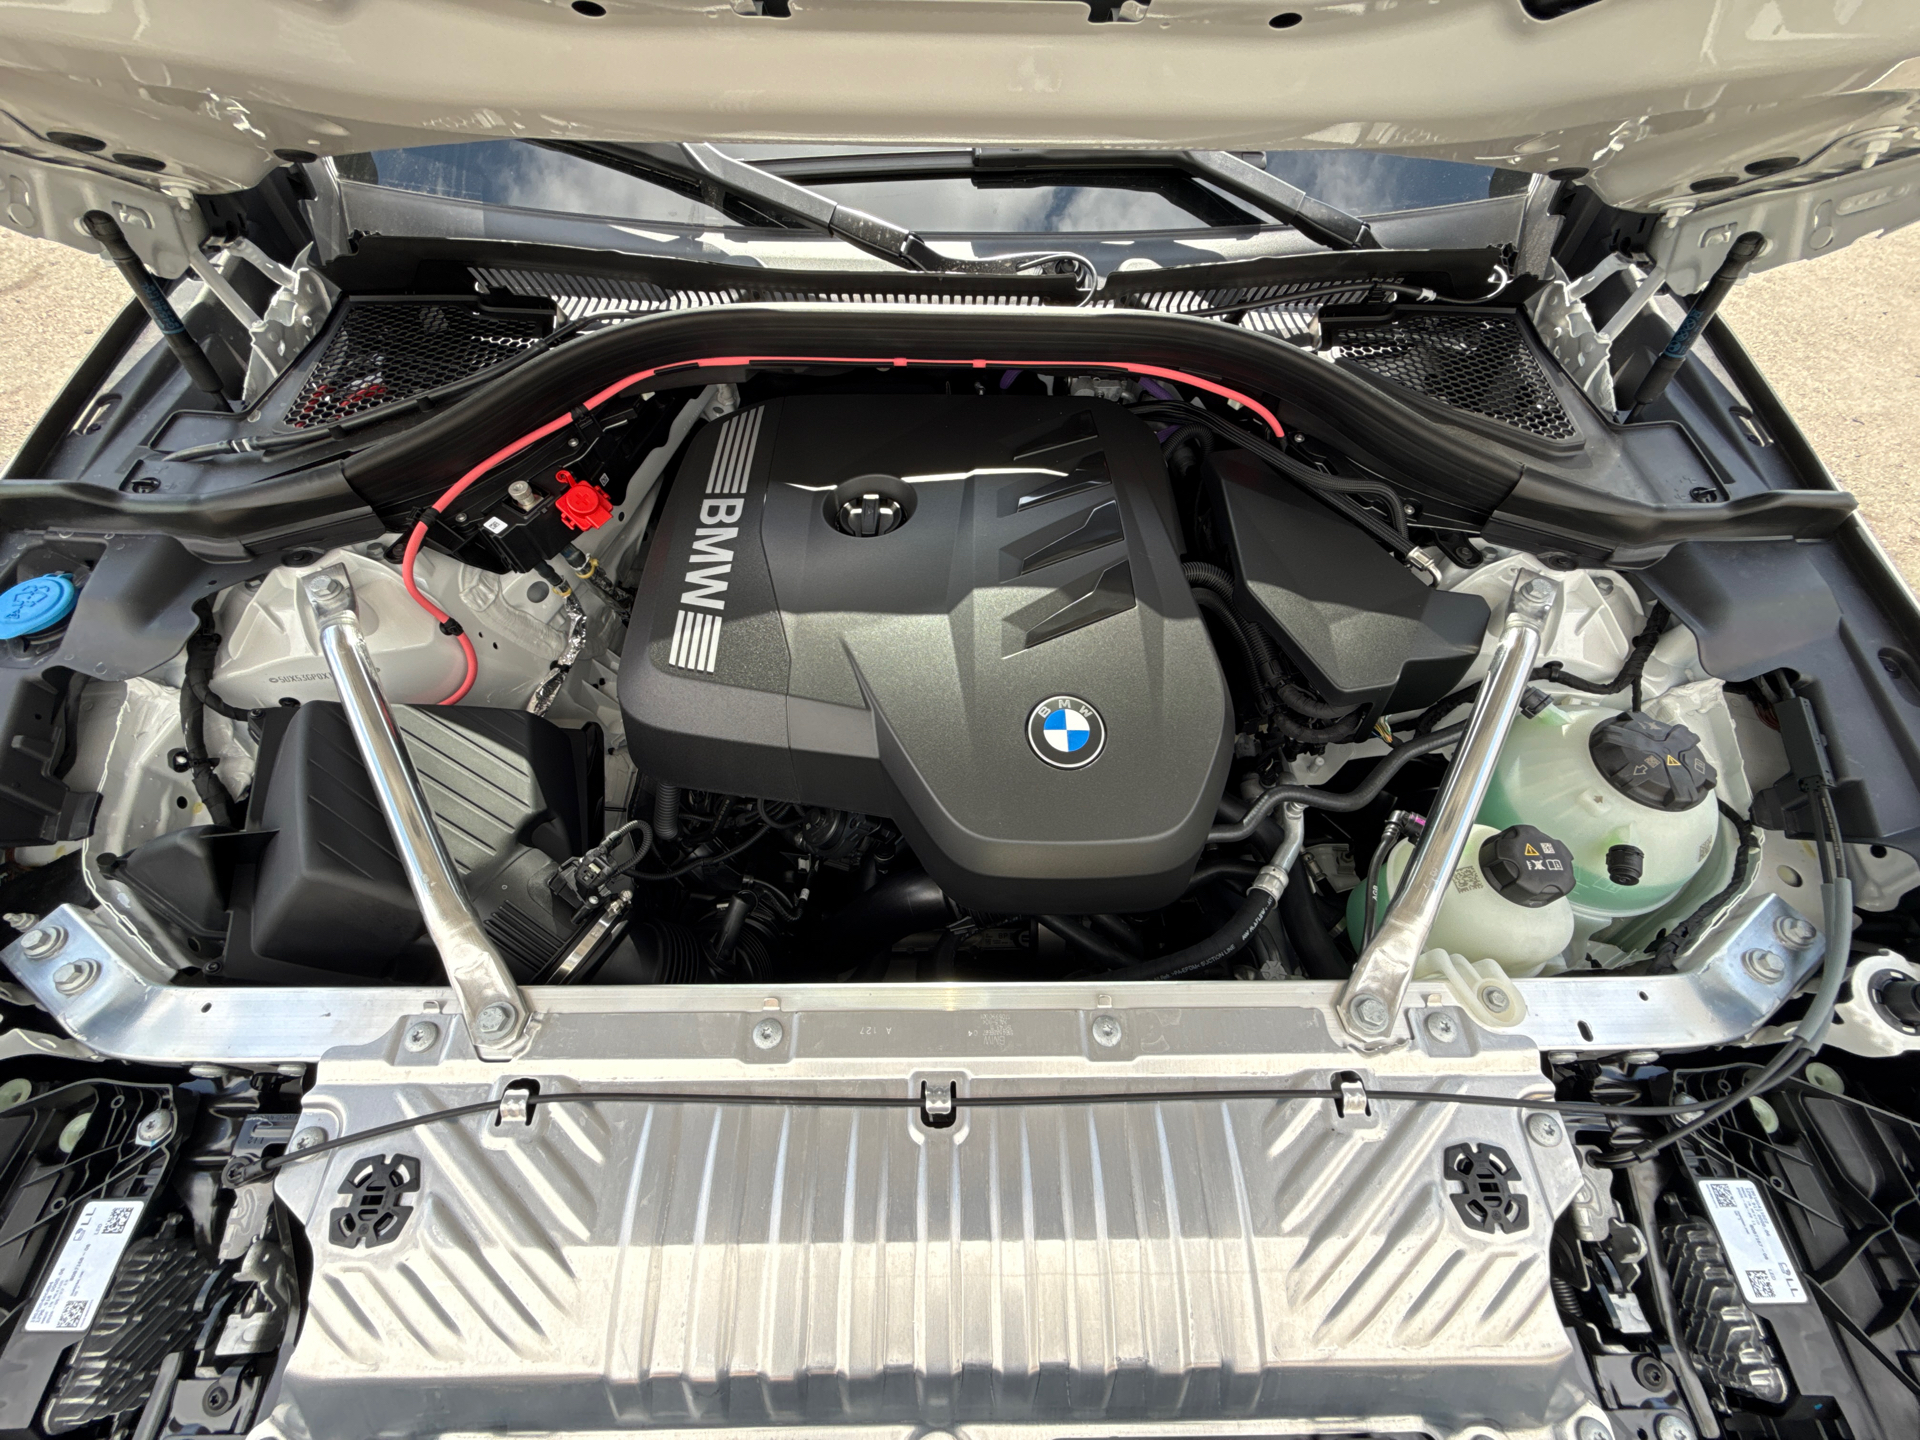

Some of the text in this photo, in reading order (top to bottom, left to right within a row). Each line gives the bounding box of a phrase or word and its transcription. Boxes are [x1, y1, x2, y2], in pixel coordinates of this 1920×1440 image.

[680, 498, 745, 610] BMW
[1038, 699, 1093, 719] BMW
[1223, 943, 1236, 955] LINE
[860, 1026, 892, 1034] A 127
[80, 1207, 96, 1225] LL
[1785, 1278, 1799, 1296] LL
